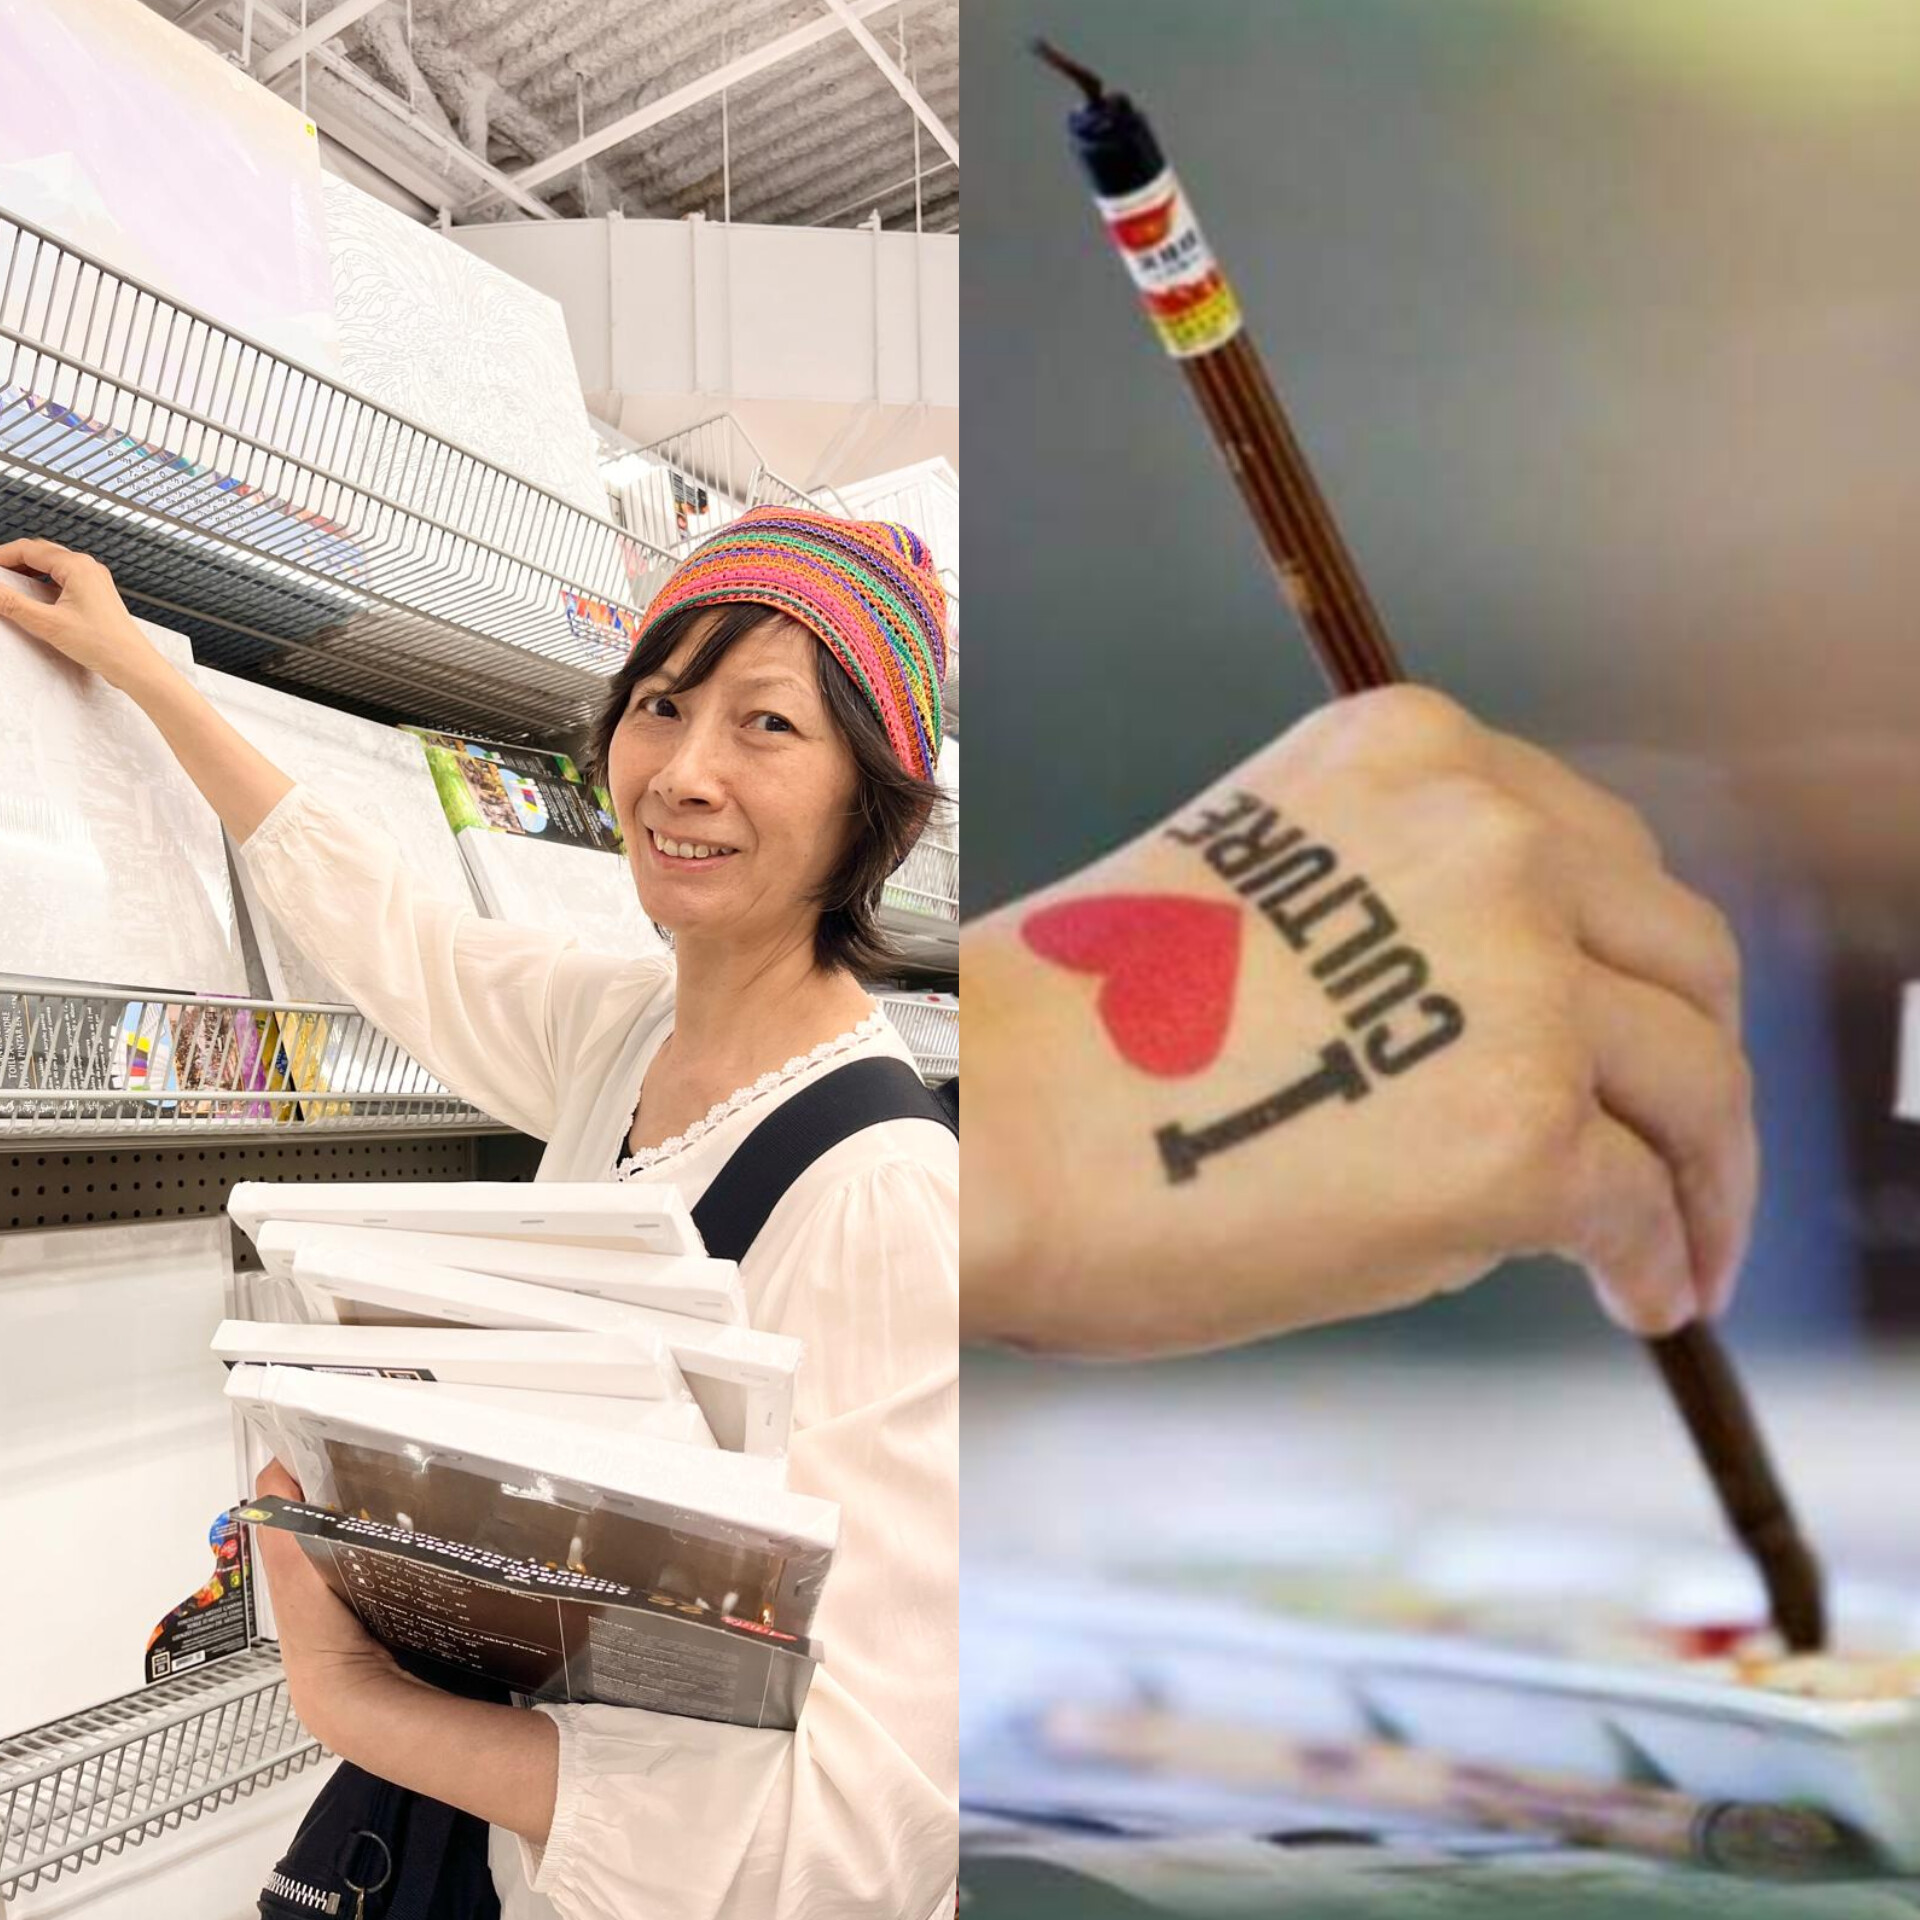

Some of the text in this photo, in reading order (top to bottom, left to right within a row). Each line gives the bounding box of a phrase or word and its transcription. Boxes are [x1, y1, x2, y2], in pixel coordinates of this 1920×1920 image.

[1154, 790, 1466, 1186] I CULTURE
[336, 1522, 410, 1544] BRUSHES
